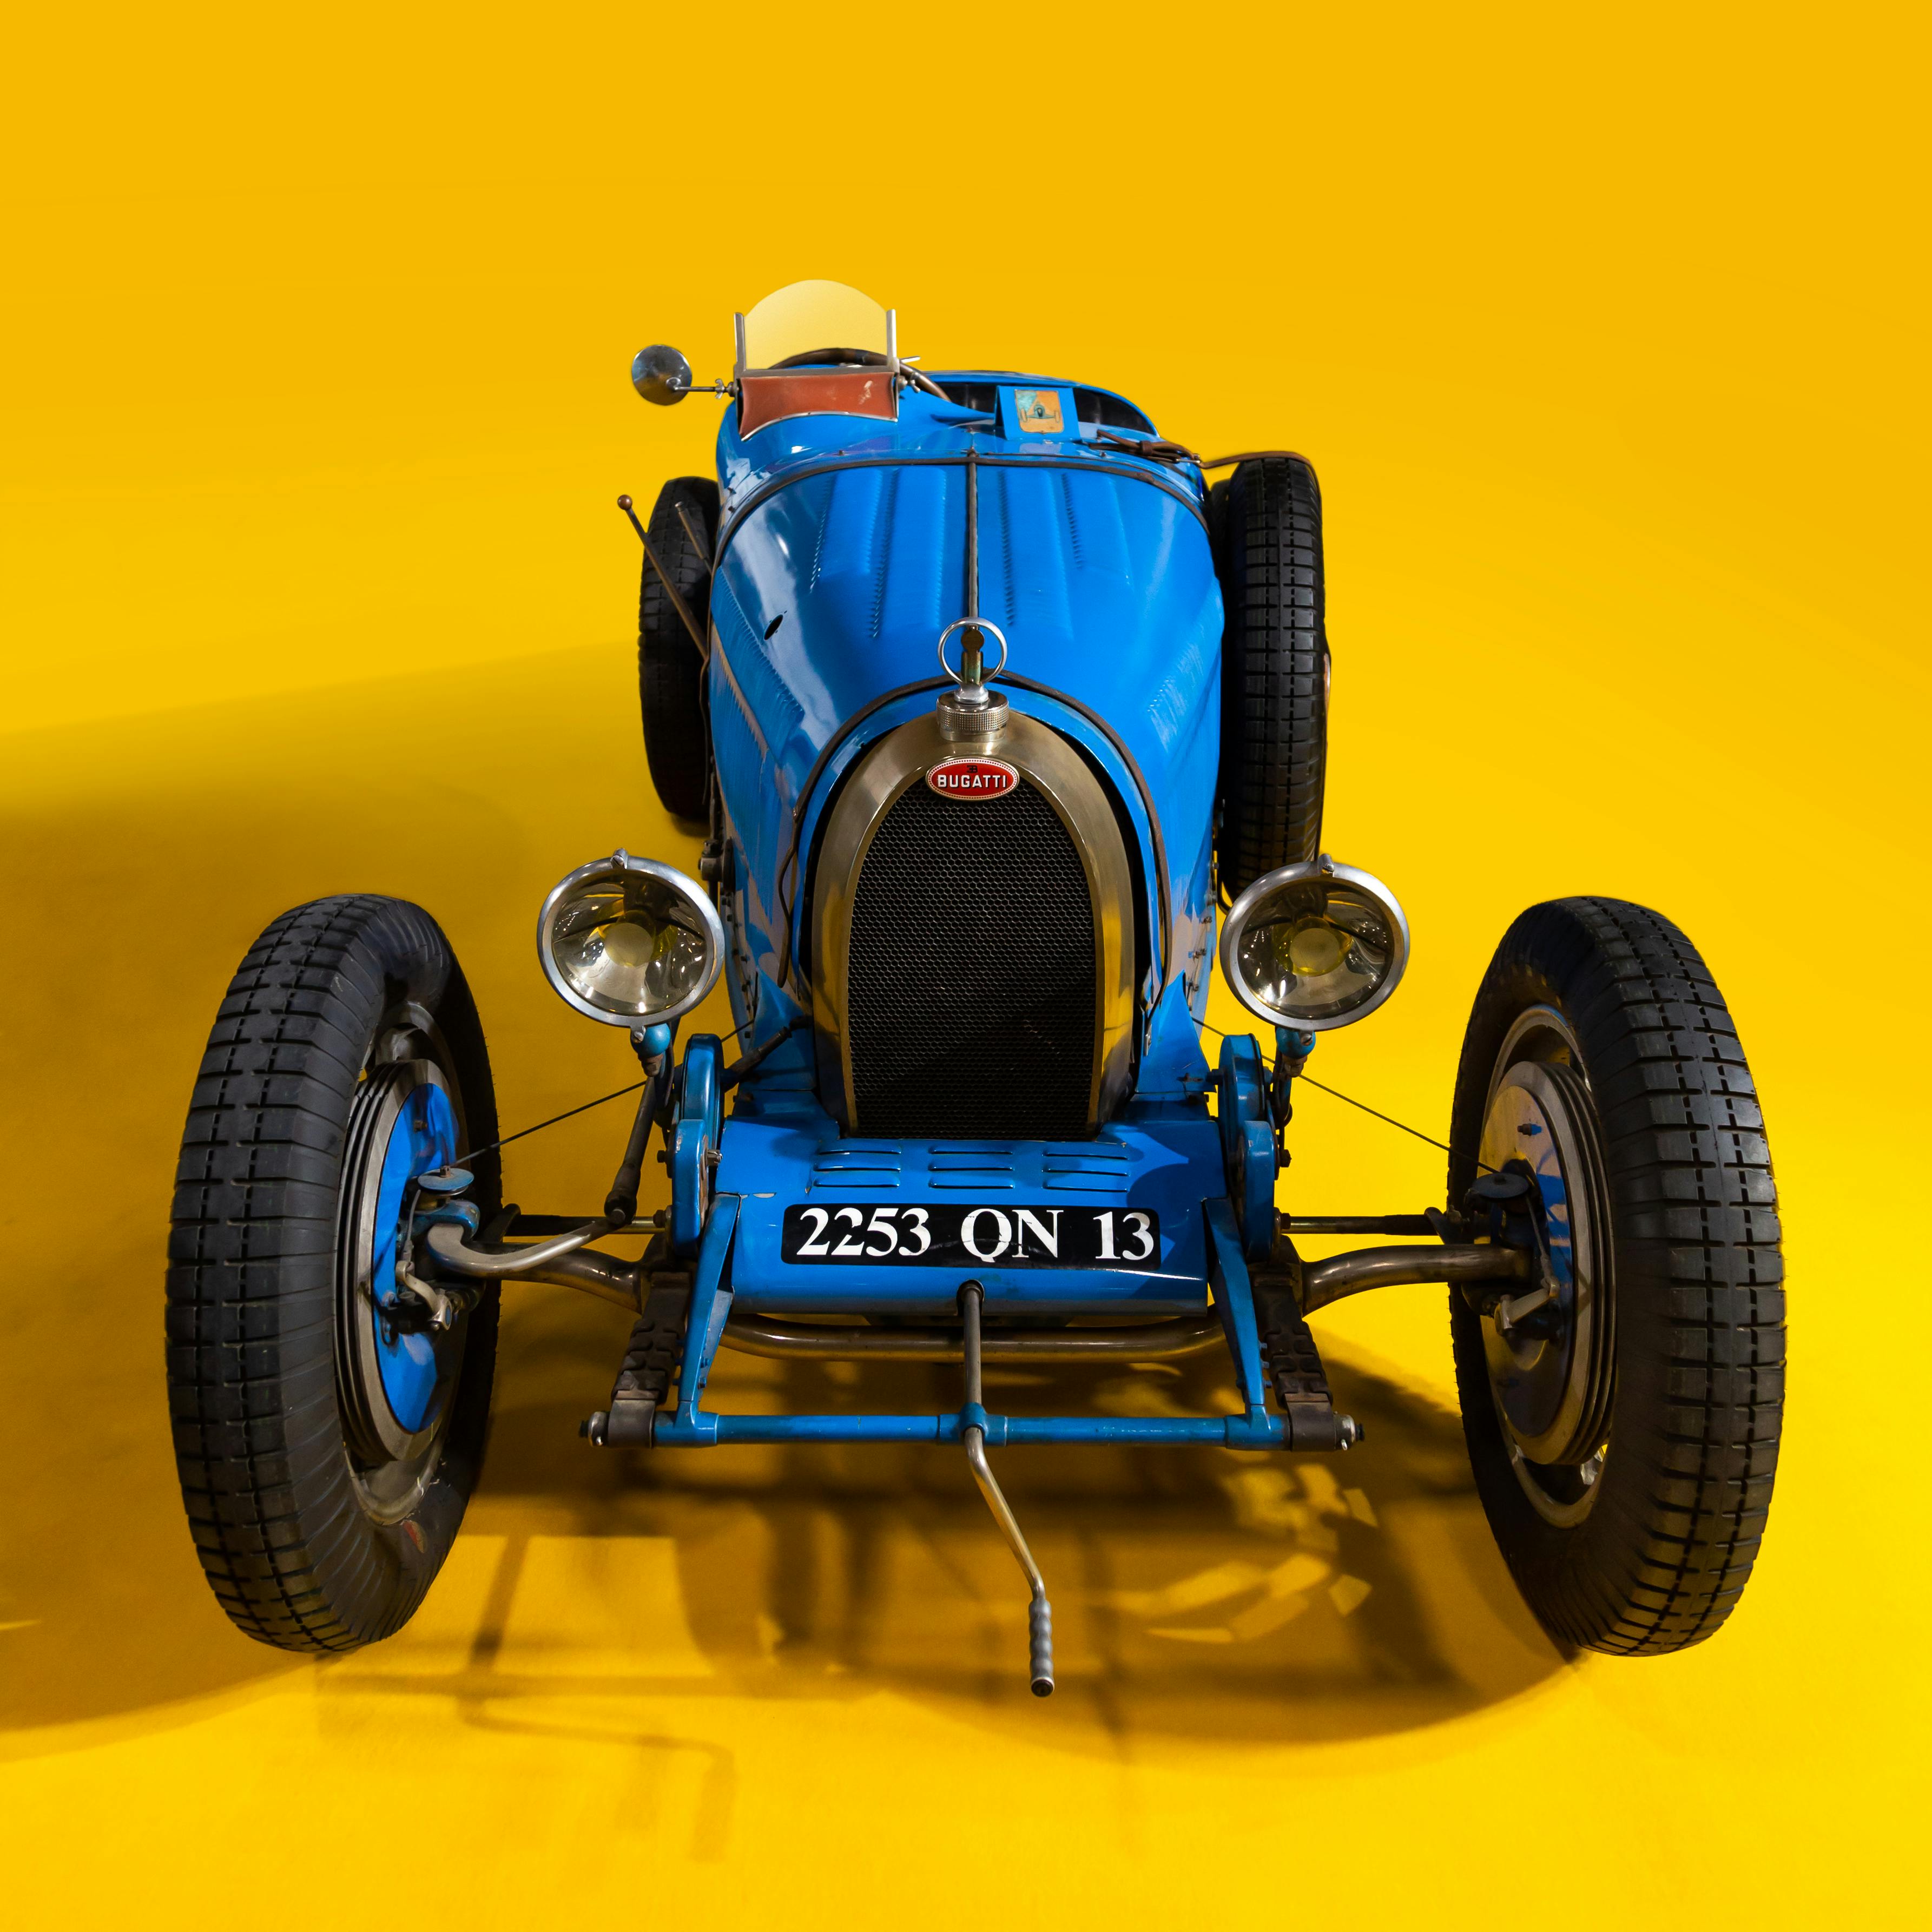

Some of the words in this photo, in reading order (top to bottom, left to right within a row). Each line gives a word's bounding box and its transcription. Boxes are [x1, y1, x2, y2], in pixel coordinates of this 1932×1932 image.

[938, 775, 1006, 788] BUGATTI
[796, 1207, 931, 1257] 2253
[961, 1208, 1064, 1263] QN
[1093, 1211, 1155, 1261] 13
